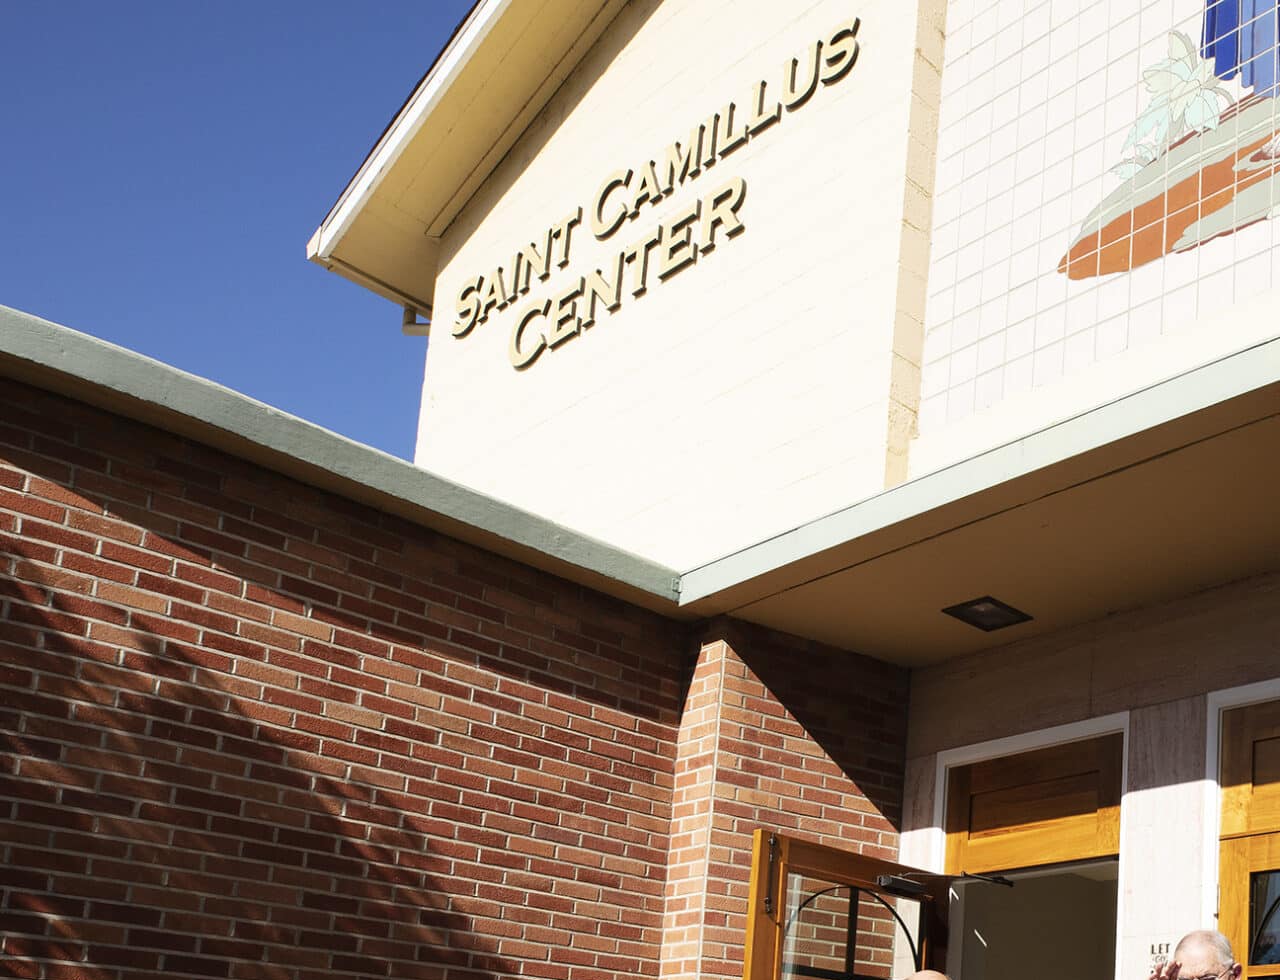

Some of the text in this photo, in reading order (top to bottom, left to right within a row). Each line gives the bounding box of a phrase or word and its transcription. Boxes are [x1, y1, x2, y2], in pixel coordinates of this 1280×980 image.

[452, 17, 861, 338] SAINT CAMILLUS
[509, 175, 747, 371] CENTER
